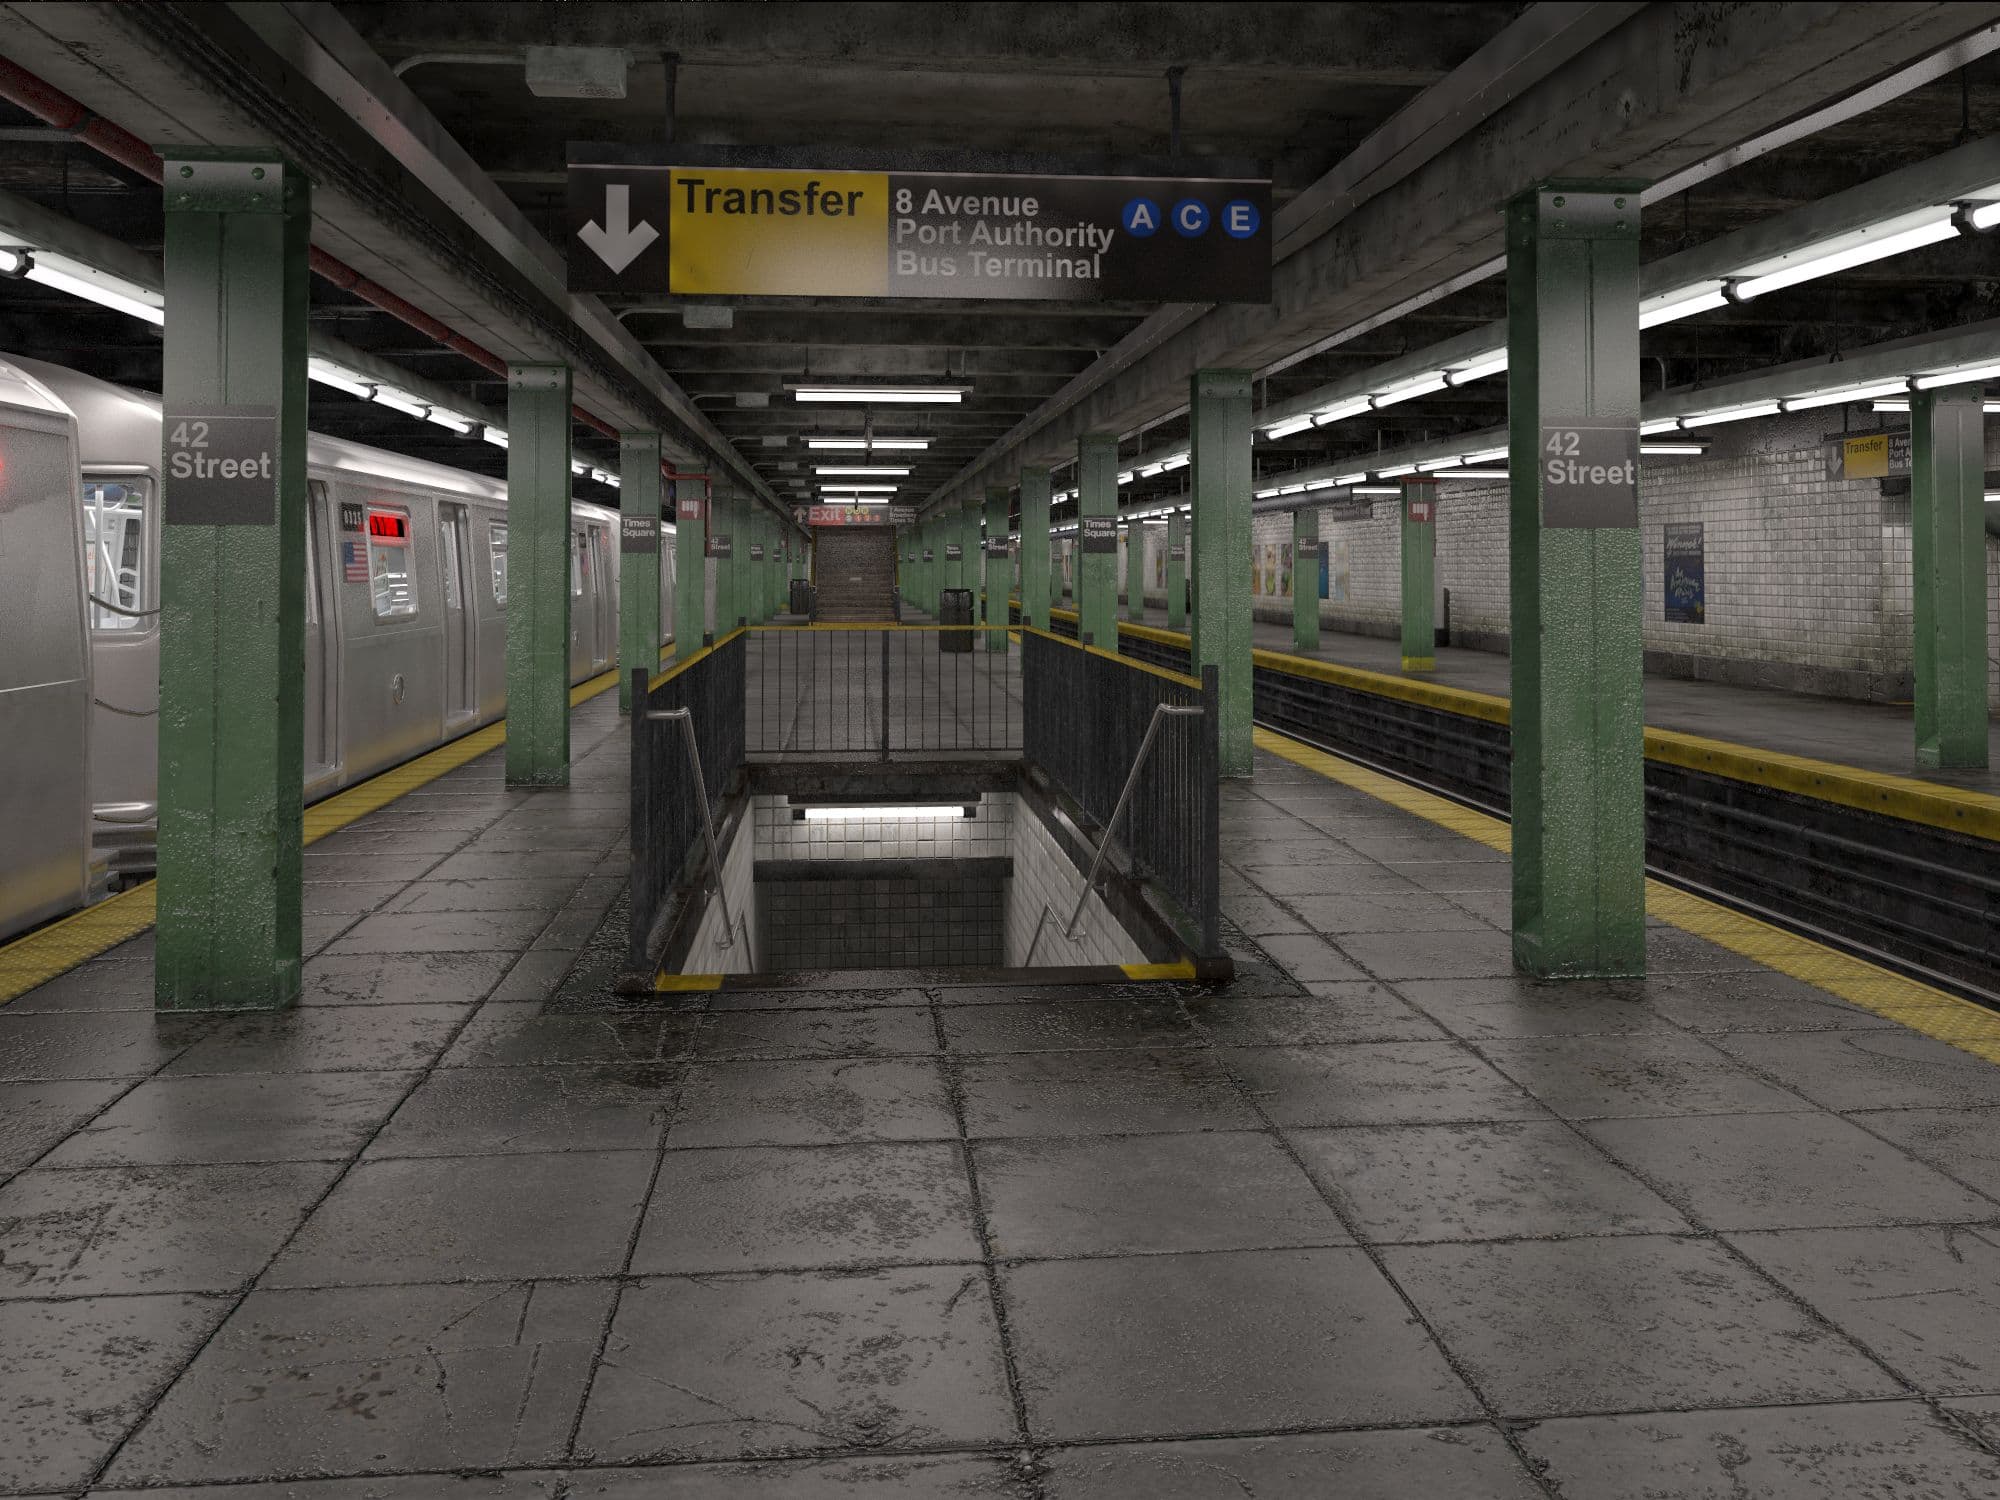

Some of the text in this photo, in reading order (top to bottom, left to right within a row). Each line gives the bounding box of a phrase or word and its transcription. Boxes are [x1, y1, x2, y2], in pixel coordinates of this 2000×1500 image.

[677, 178, 864, 217] Transfer
[896, 188, 1039, 217] 8 Avenue
[1130, 204, 1251, 231] A C E
[896, 218, 1115, 254] Port Authority
[896, 251, 1101, 280] Bus Terminal
[170, 421, 209, 448] 42
[1546, 431, 1580, 456] 42
[1845, 439, 1883, 454] Transfer
[170, 451, 271, 479] Street
[1889, 448, 1904, 458] Port
[1889, 459, 1903, 469] Bus
[1547, 459, 1635, 485] Street
[622, 518, 651, 528] Times
[809, 506, 841, 521] Exit
[1083, 519, 1112, 529] Times
[622, 528, 656, 538] Square
[1083, 529, 1116, 539] Square
